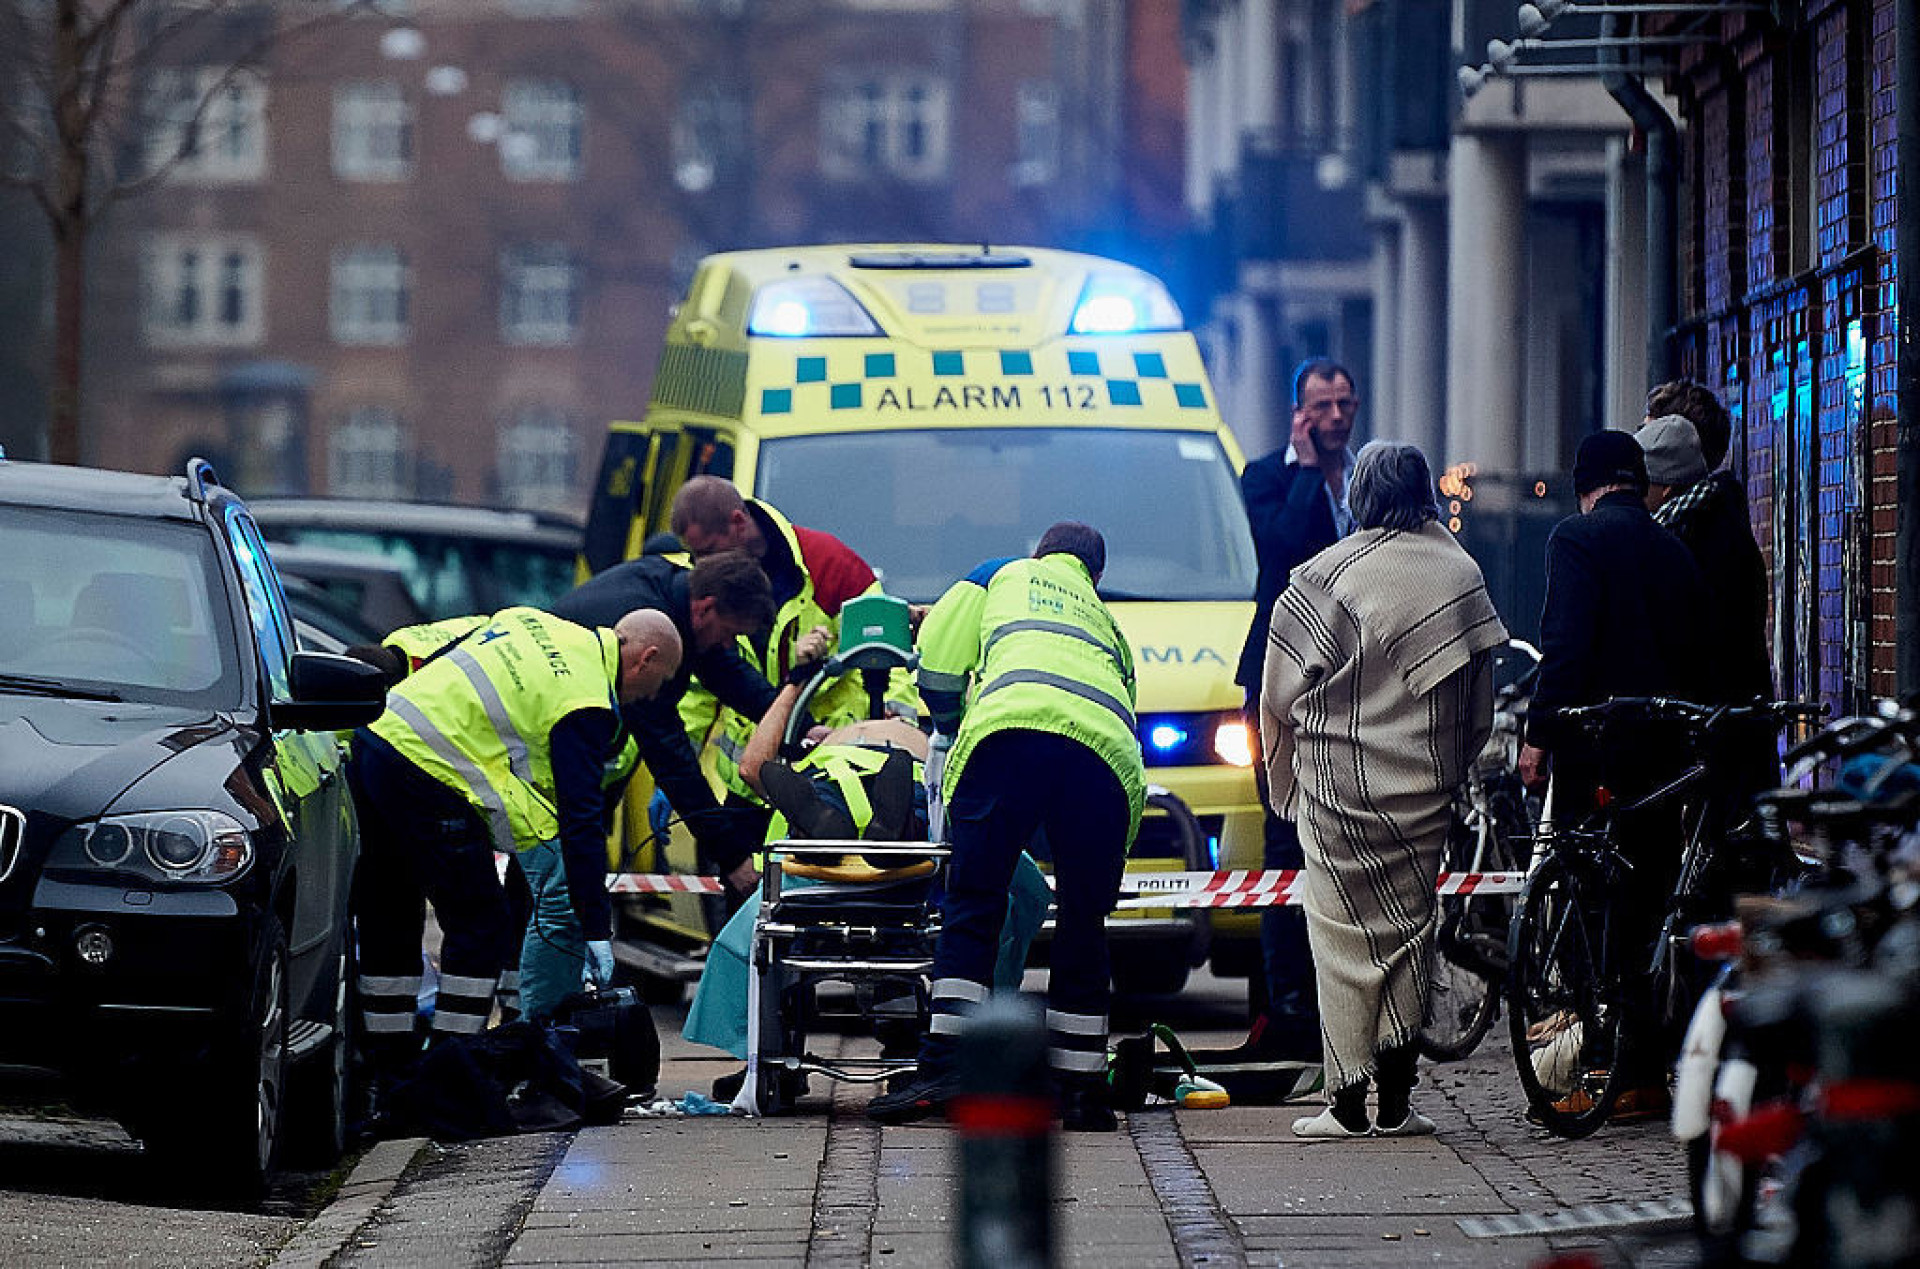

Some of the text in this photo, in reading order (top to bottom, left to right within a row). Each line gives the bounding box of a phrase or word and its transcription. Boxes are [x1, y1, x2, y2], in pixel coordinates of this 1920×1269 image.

[877, 384, 1098, 411] ALARM 112
[1137, 878, 1190, 889] POLITI
